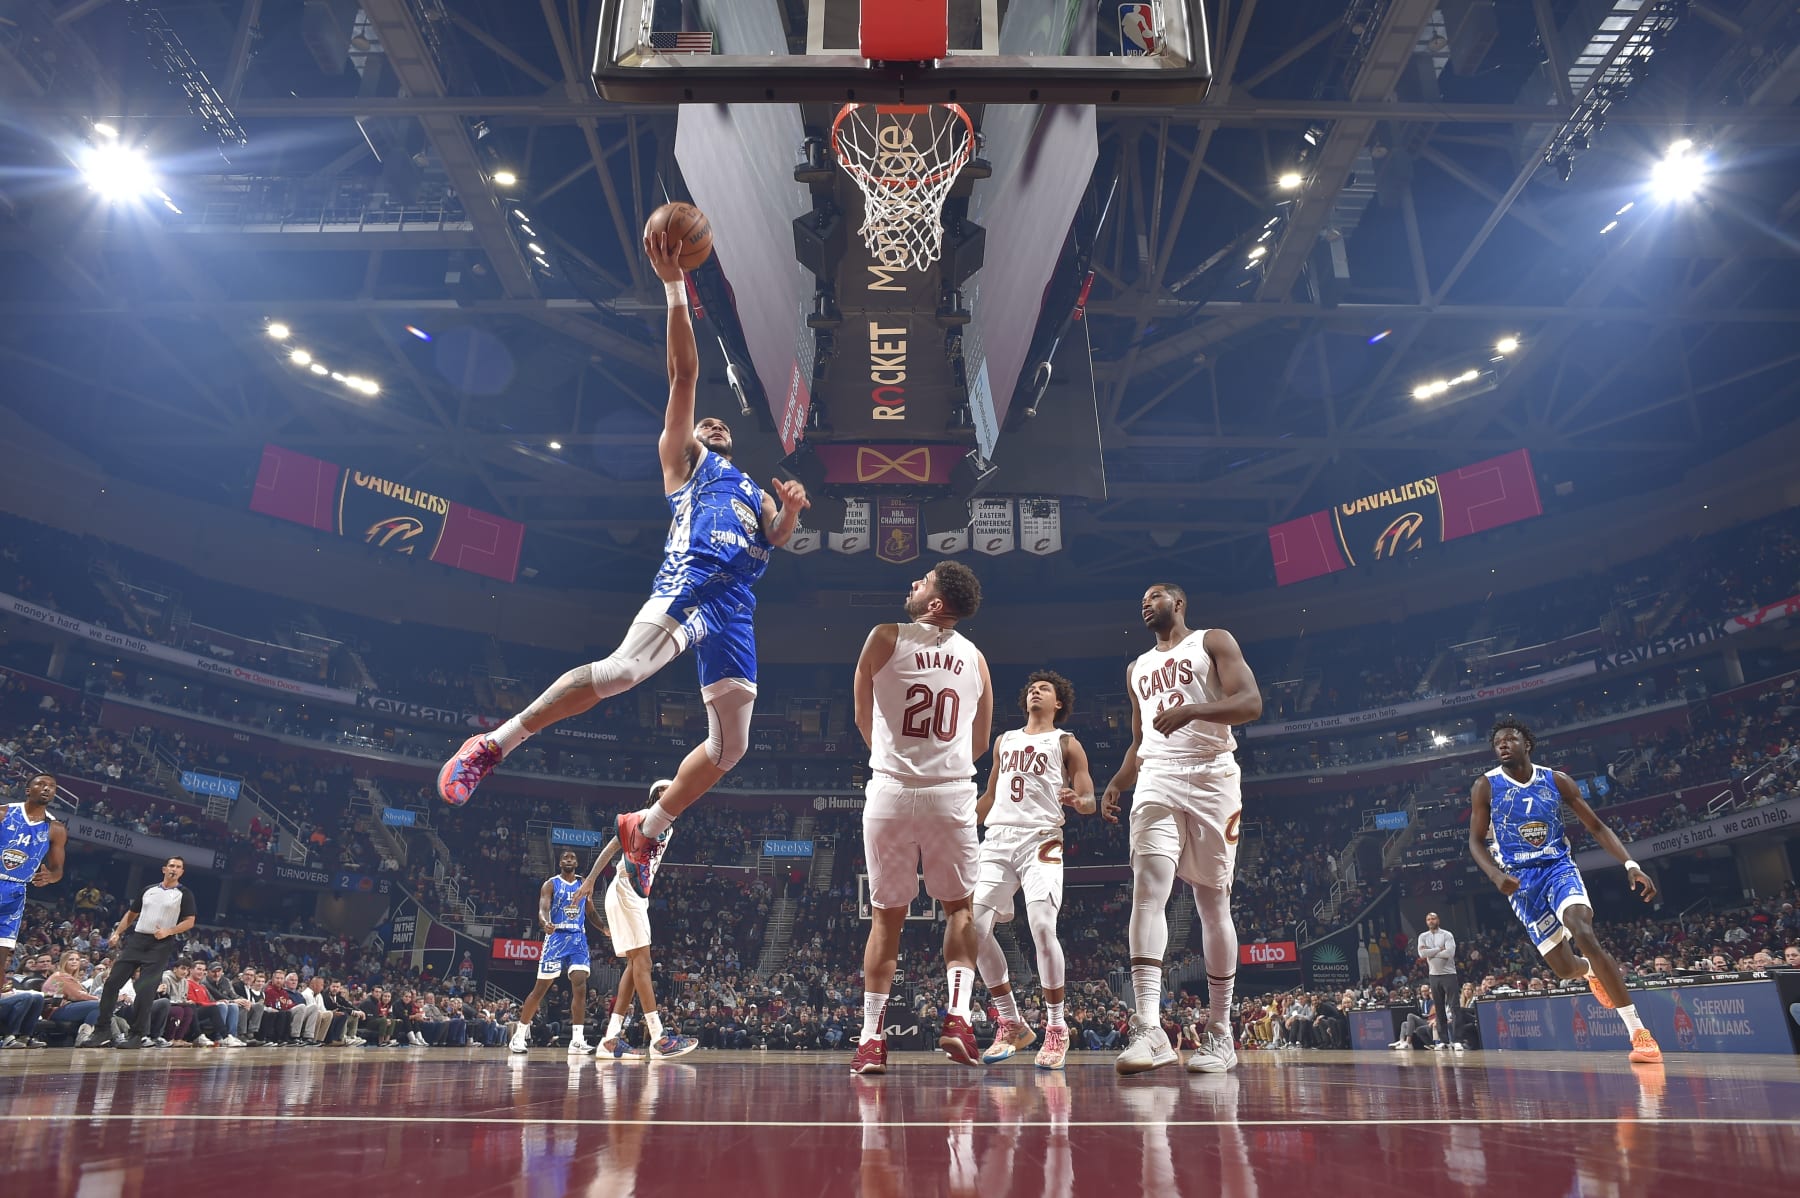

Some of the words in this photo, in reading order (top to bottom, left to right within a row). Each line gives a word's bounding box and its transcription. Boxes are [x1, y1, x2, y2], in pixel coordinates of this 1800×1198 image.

[869, 321, 907, 420] ROCKET
[354, 471, 447, 515] CAVALIERS
[739, 480, 753, 496] 4
[1342, 478, 1437, 516] CAVALIERS
[880, 516, 916, 525] CHAMPIONS
[14, 601, 55, 623] money's
[88, 627, 103, 638] we
[105, 634, 123, 645] can
[125, 638, 149, 653] help.
[197, 659, 233, 676] KeyBank
[915, 652, 964, 675] NIANG
[1138, 658, 1193, 700] CAVS
[1441, 692, 1476, 706] KeyBank
[902, 683, 960, 742] 20
[1284, 720, 1319, 732] money's
[1349, 714, 1360, 722] we
[1362, 711, 1377, 721] can
[1379, 707, 1399, 718] help.
[554, 727, 569, 736] LET
[1001, 746, 1048, 776] CAVS
[182, 773, 236, 795] Sheely's
[1010, 776, 1025, 803] 9
[828, 796, 865, 809] Huntin
[1522, 797, 1534, 814] 7
[79, 822, 93, 836] we
[94, 829, 112, 842] can
[113, 833, 134, 848] help.
[553, 830, 598, 843] Sheely's
[1652, 832, 1689, 853] money's
[1691, 825, 1716, 843] hard.
[1723, 822, 1738, 834] we
[1741, 815, 1761, 830] can
[1762, 807, 1792, 824] help.
[17, 832, 31, 847] 14
[765, 842, 810, 854] Sheely's
[256, 862, 264, 875] 5
[276, 866, 329, 884] TURNOVERS
[341, 876, 349, 888] 2
[1431, 880, 1443, 891] 23
[394, 922, 401, 932] IN
[401, 921, 415, 932] THE
[1527, 920, 1540, 938] 7
[392, 932, 413, 943] PAINT
[504, 940, 539, 959] fubo
[1250, 944, 1285, 962] fubo
[1508, 1009, 1538, 1022] SHERWIN
[1587, 1004, 1619, 1019] SHERW
[1693, 998, 1744, 1016] SHERWIN
[883, 1024, 918, 1036] KIA
[1509, 1024, 1541, 1038] WILLIAMS
[1696, 1018, 1751, 1035] WILLIAMS
